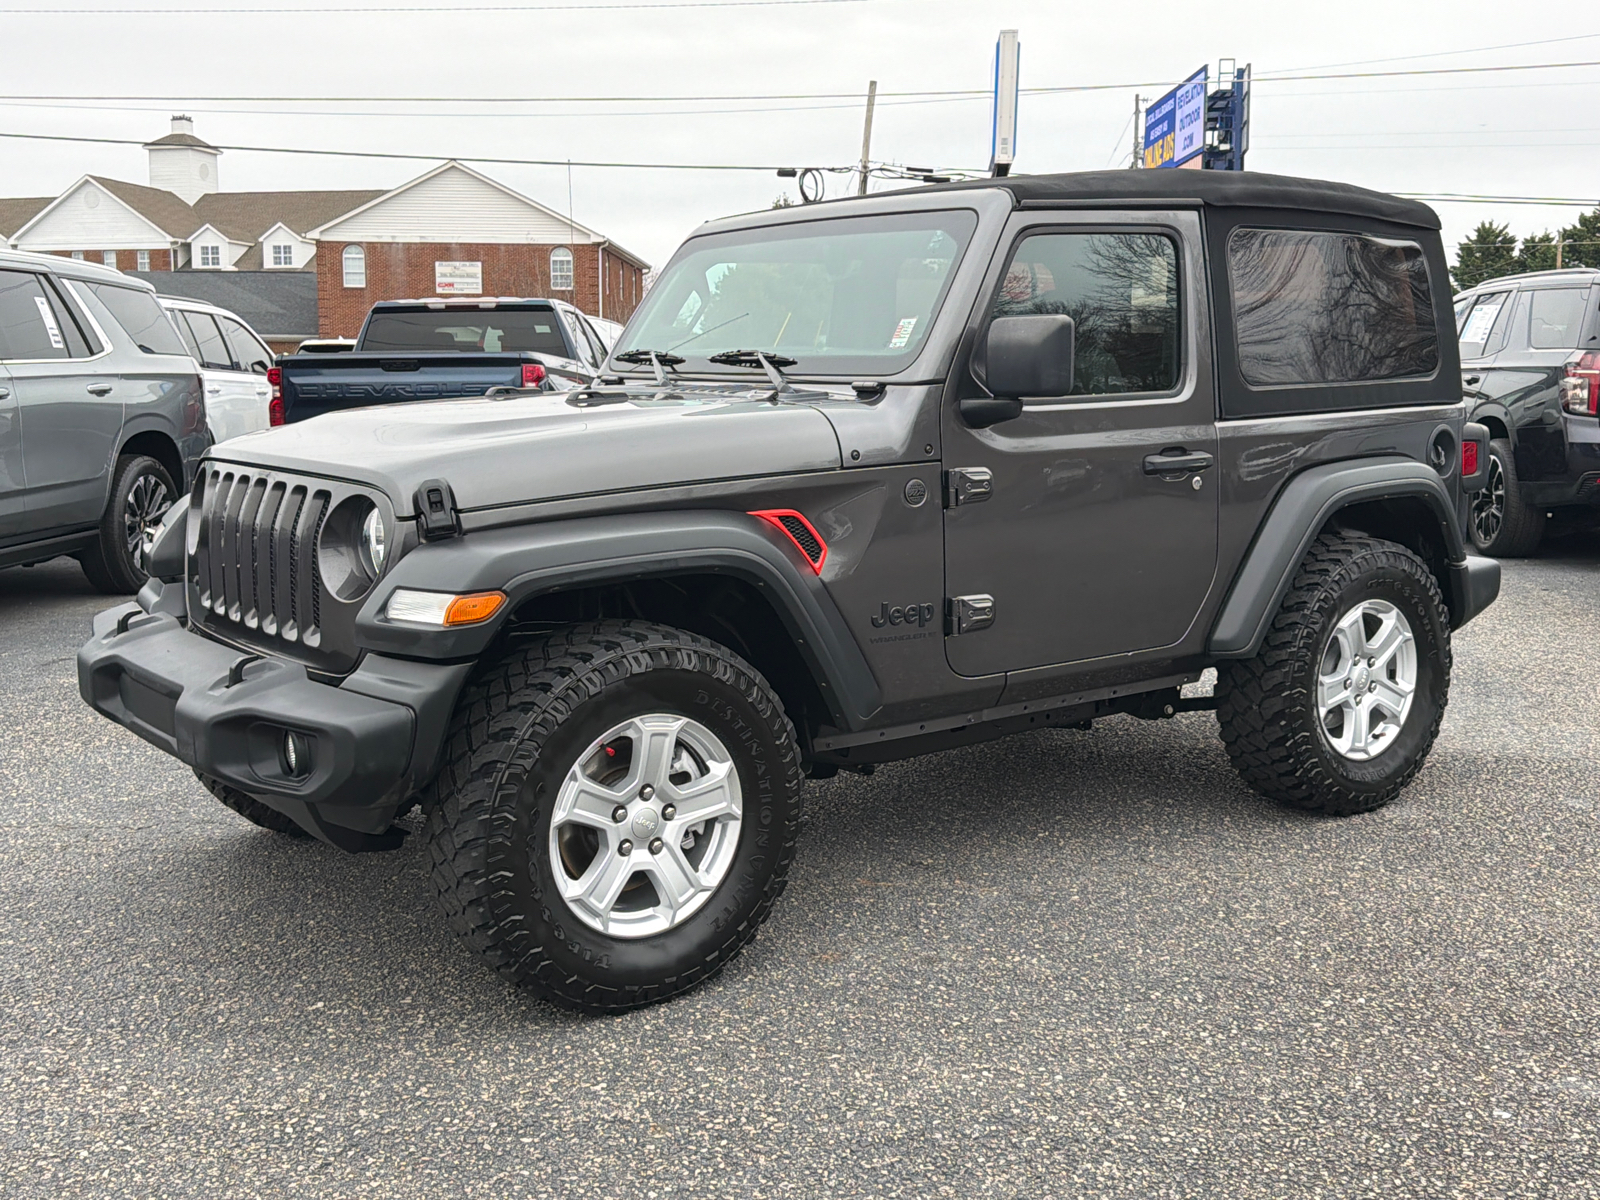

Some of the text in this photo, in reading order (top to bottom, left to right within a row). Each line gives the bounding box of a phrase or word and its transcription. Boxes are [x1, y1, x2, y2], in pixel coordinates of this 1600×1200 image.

[1179, 106, 1201, 132] OUTDOOR
[1163, 131, 1175, 163] ADS
[870, 601, 935, 629] Jeep
[869, 632, 927, 645] WRANGLER
[695, 688, 774, 849] DESTINATION
